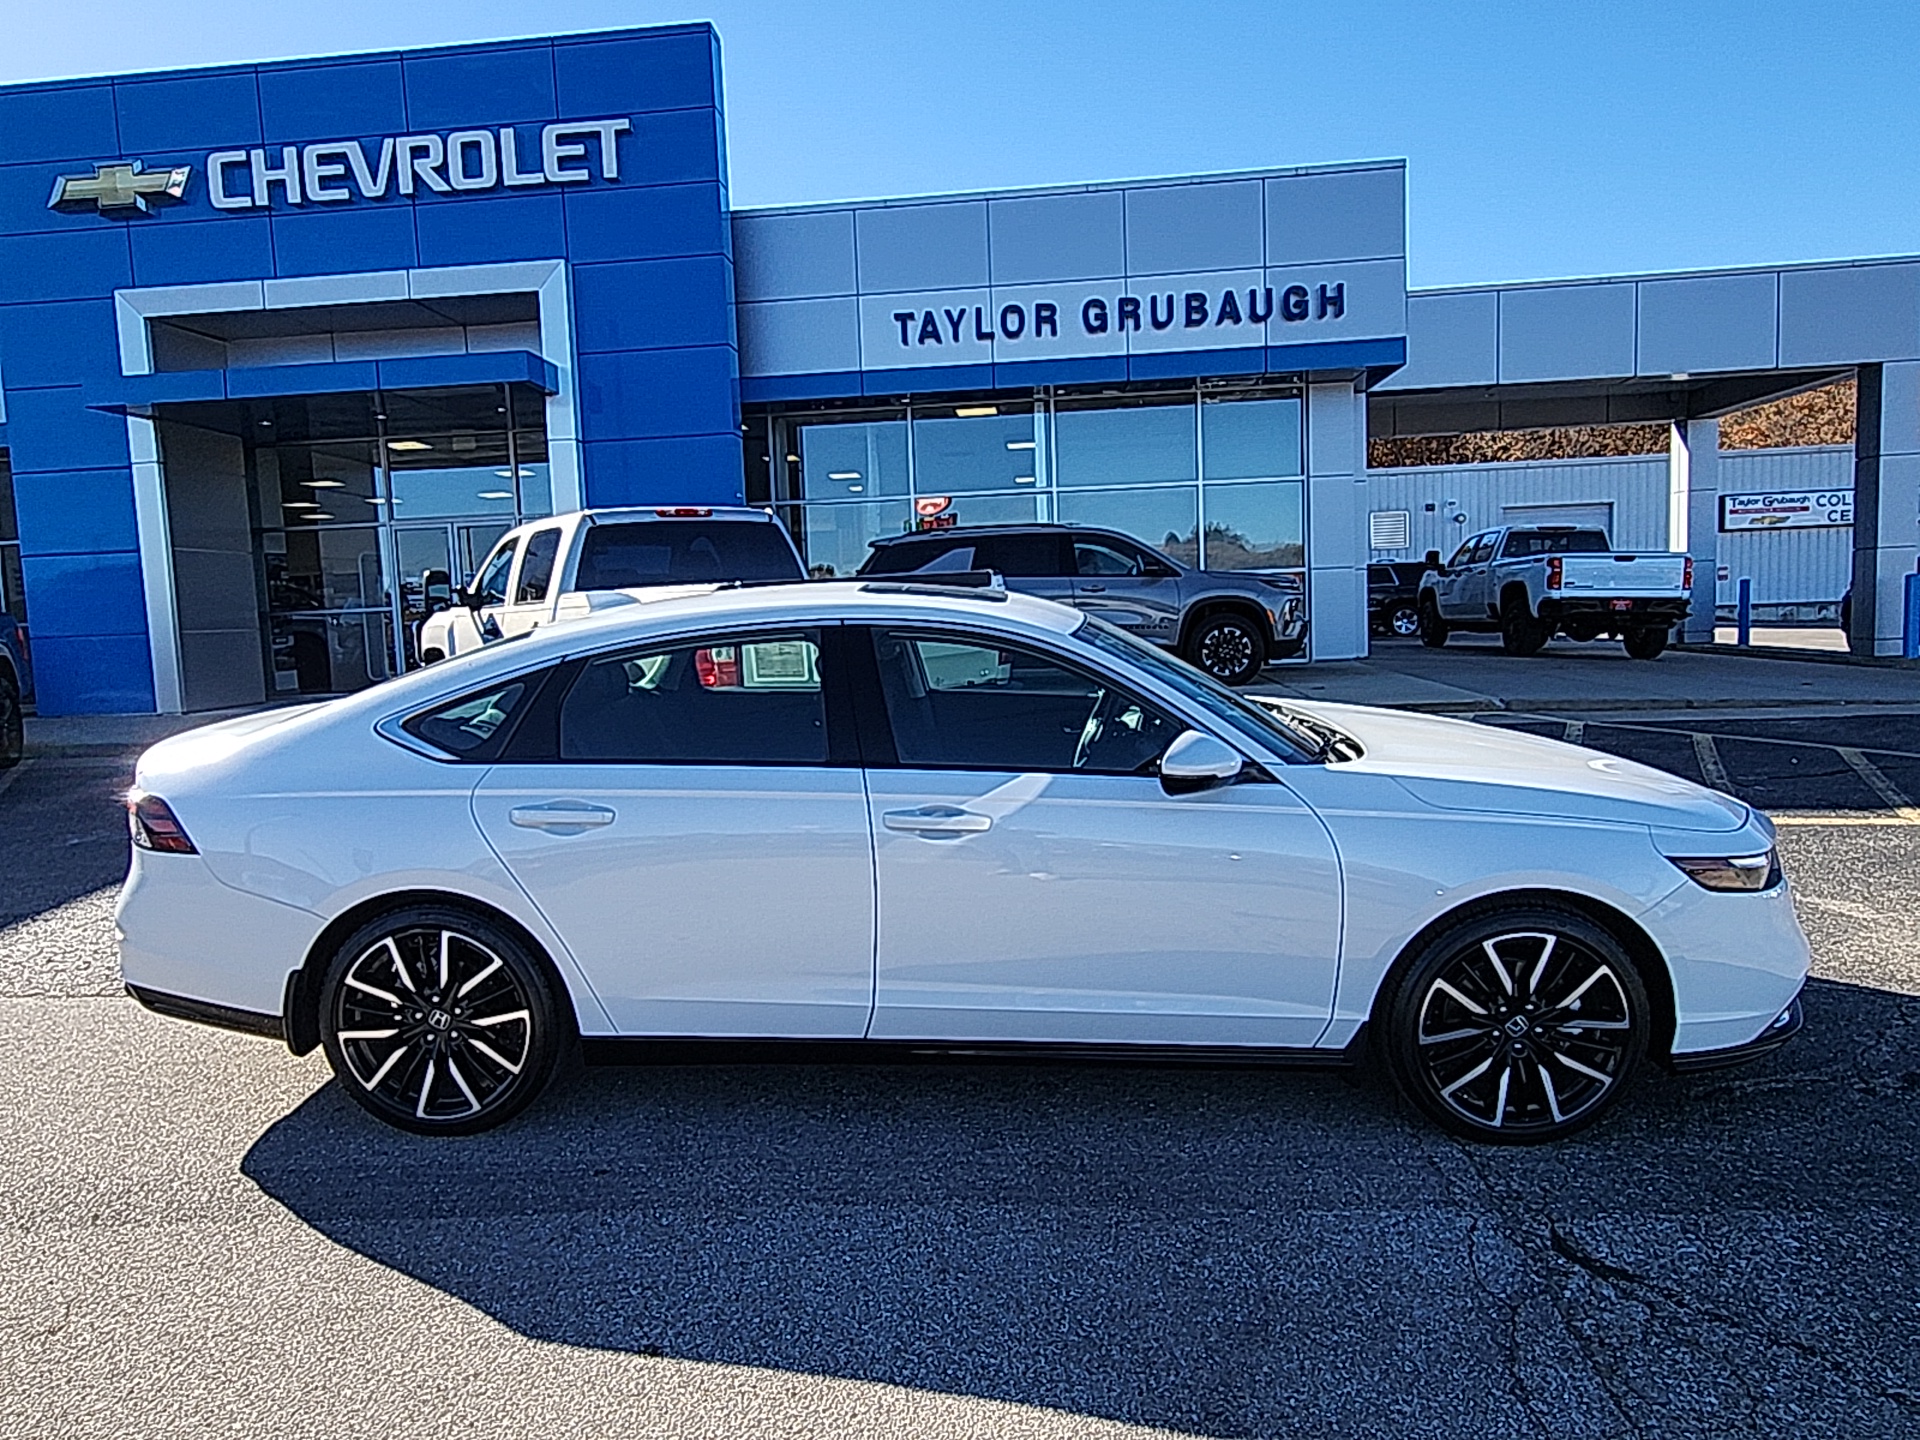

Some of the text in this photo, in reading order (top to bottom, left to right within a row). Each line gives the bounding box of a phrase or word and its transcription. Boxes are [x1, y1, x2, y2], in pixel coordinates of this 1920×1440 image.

[208, 119, 630, 209] CHEVROLET
[893, 282, 1345, 346] TAYLOR GRUBAUGH
[1729, 495, 1810, 508] Taylor Grubaugh
